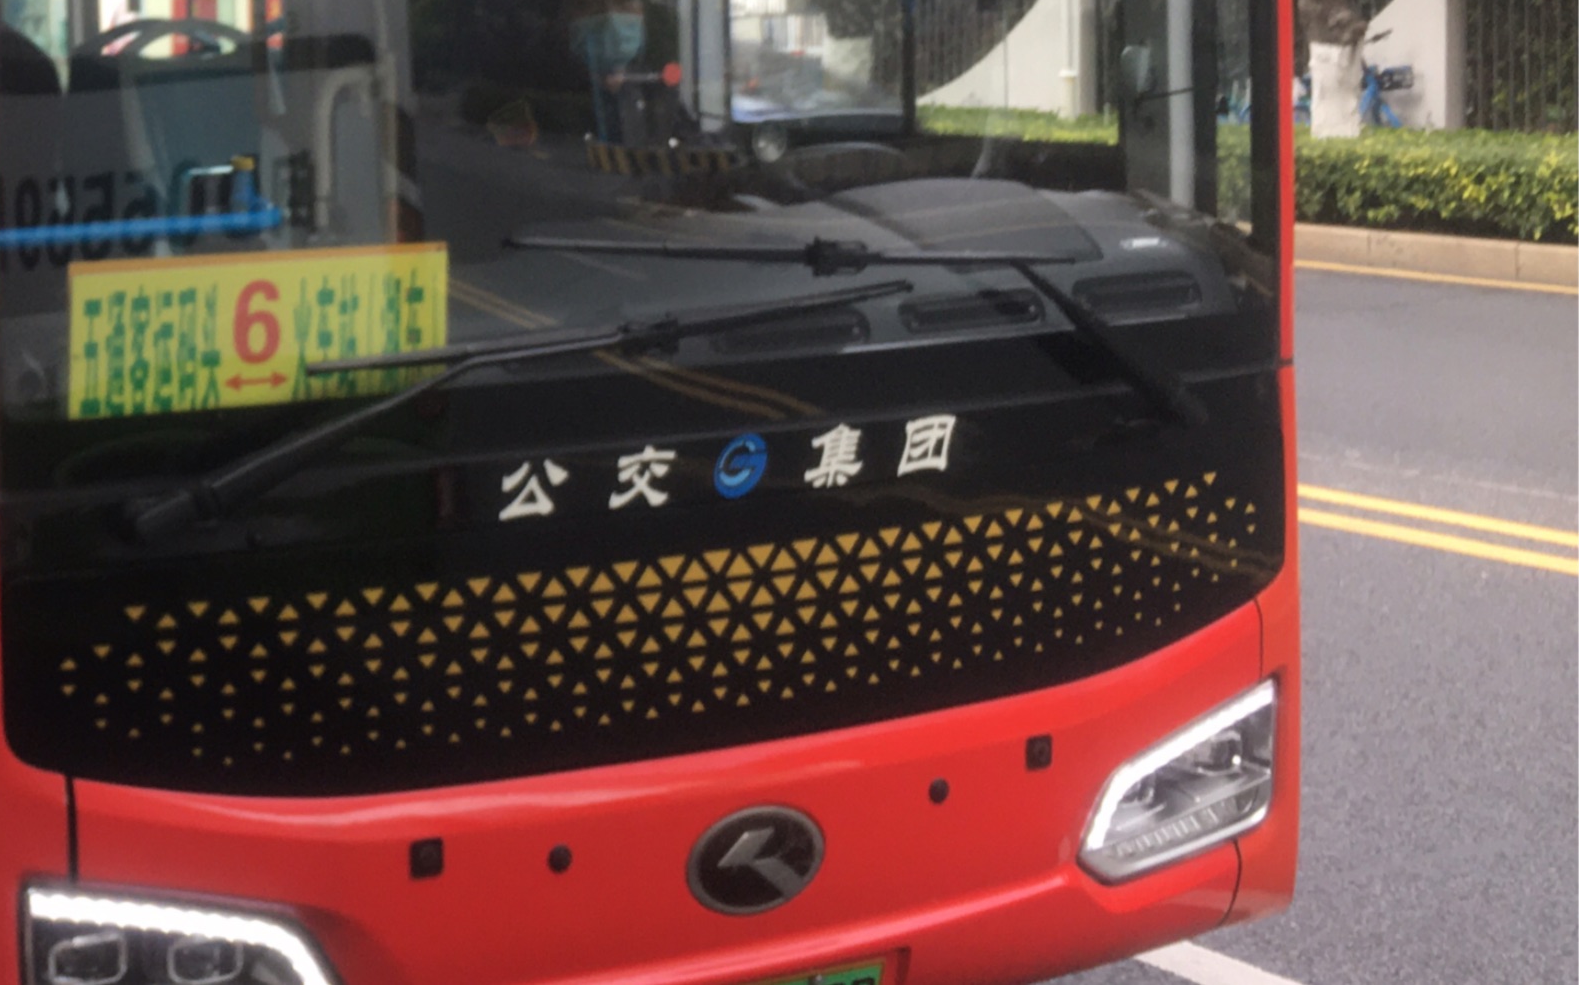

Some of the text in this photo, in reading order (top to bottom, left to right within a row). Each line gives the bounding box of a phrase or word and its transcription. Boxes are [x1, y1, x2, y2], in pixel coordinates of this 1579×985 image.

[232, 278, 281, 365] 6
[497, 412, 958, 522] 公交 集团
